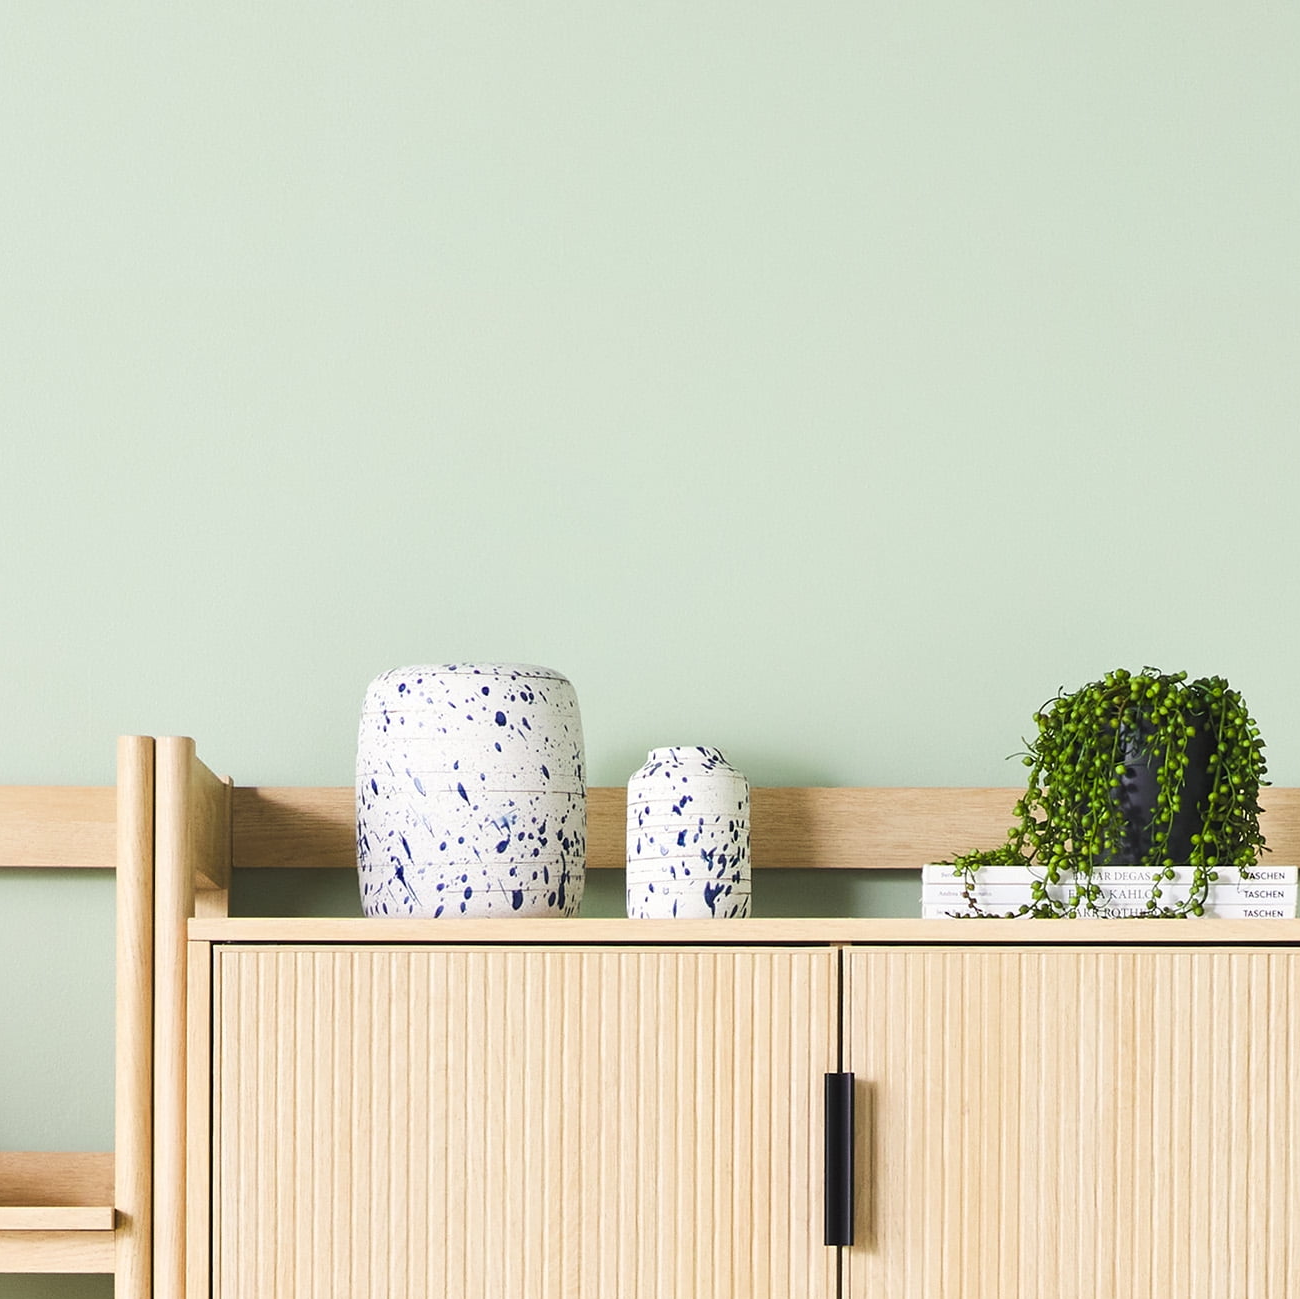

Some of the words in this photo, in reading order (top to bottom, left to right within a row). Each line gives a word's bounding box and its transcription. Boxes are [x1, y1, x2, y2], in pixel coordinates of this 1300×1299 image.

[1114, 872, 1151, 881] DEGAS
[1244, 890, 1285, 898] TASCHEN
[1243, 909, 1284, 917] TASCHEN
